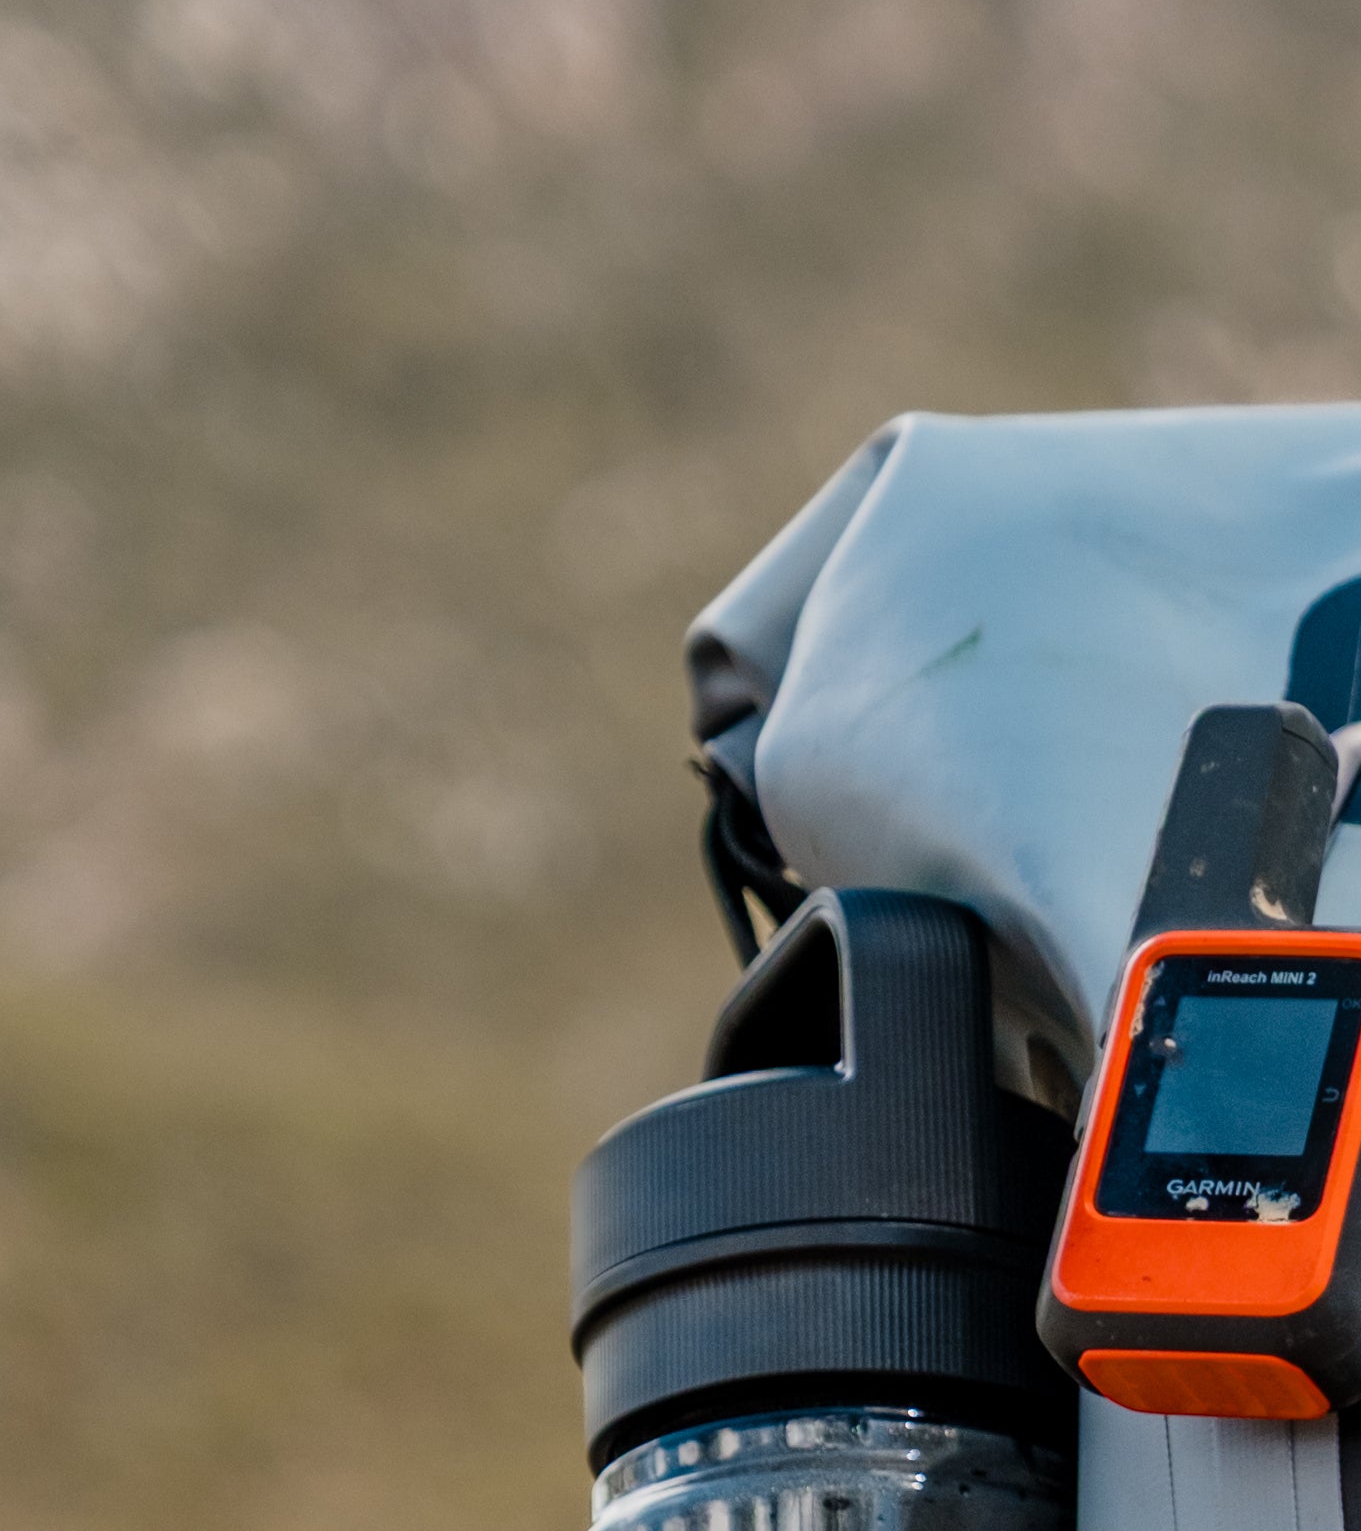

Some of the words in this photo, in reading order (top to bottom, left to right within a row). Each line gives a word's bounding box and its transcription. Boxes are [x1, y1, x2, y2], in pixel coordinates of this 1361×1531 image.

[1206, 969, 1268, 984] inReach
[1270, 970, 1304, 985] MINI
[1306, 971, 1317, 986] 2
[1341, 997, 1361, 1010] OK
[1166, 1178, 1262, 1196] GARMIN
